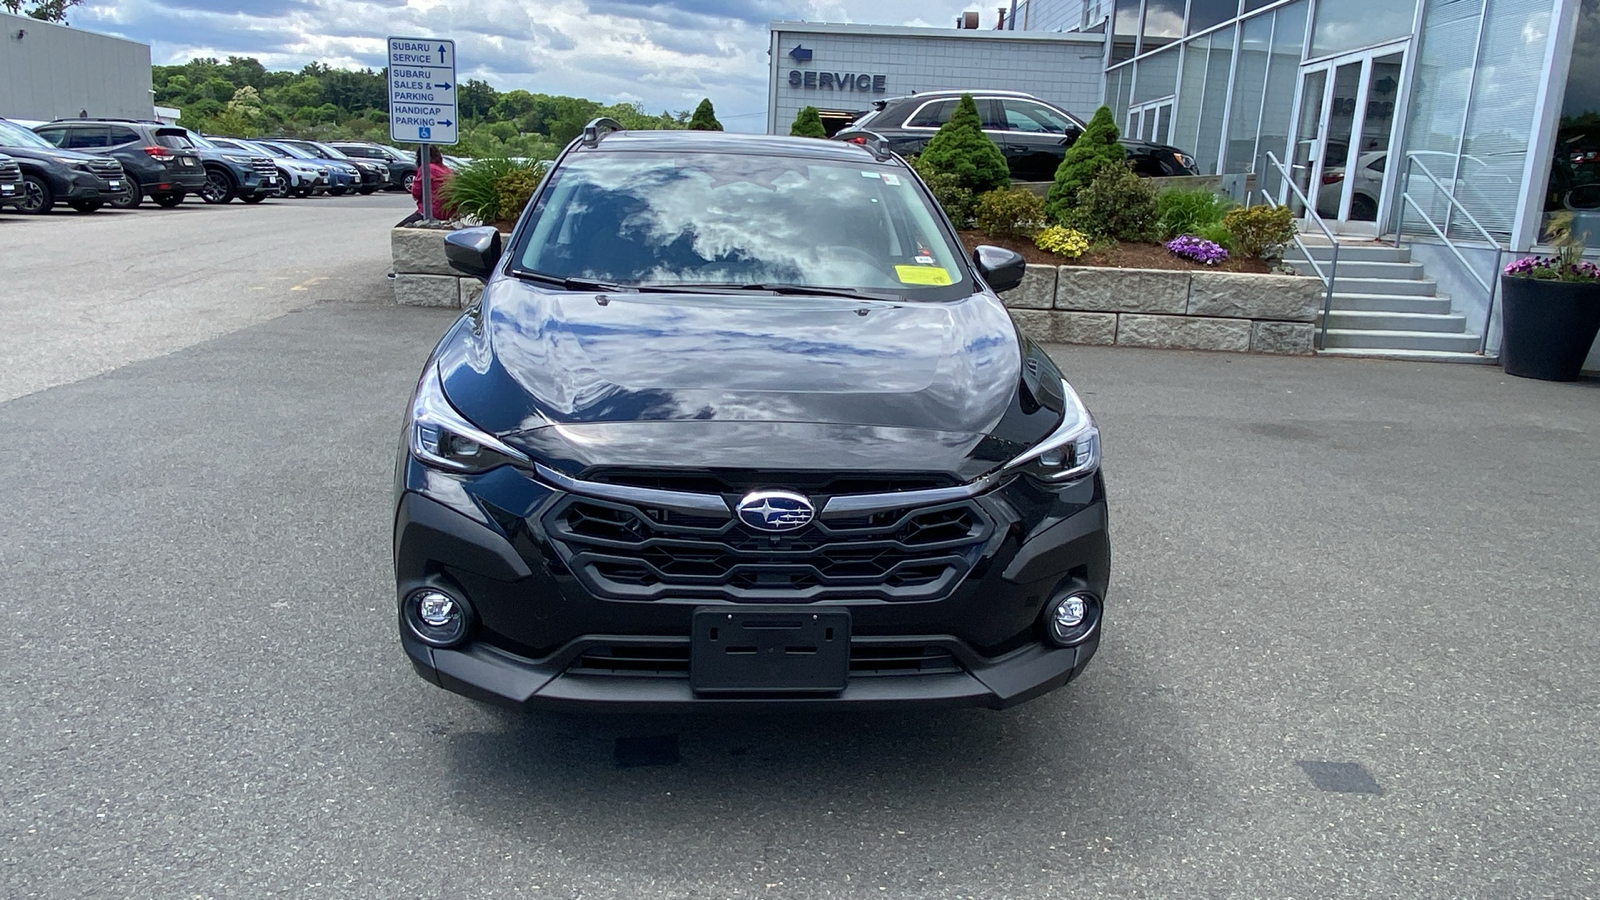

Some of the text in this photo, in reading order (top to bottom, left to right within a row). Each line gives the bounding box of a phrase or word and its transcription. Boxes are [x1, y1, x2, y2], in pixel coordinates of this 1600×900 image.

[392, 42, 430, 52] SUBARU
[392, 53, 431, 63] SERVICE
[393, 69, 431, 79] SUBARU
[394, 81, 432, 90] SALES &
[788, 70, 886, 93] SERVICE
[394, 92, 434, 101] PARKING
[395, 105, 441, 115] HANDICAP
[395, 117, 435, 126] PARKING
